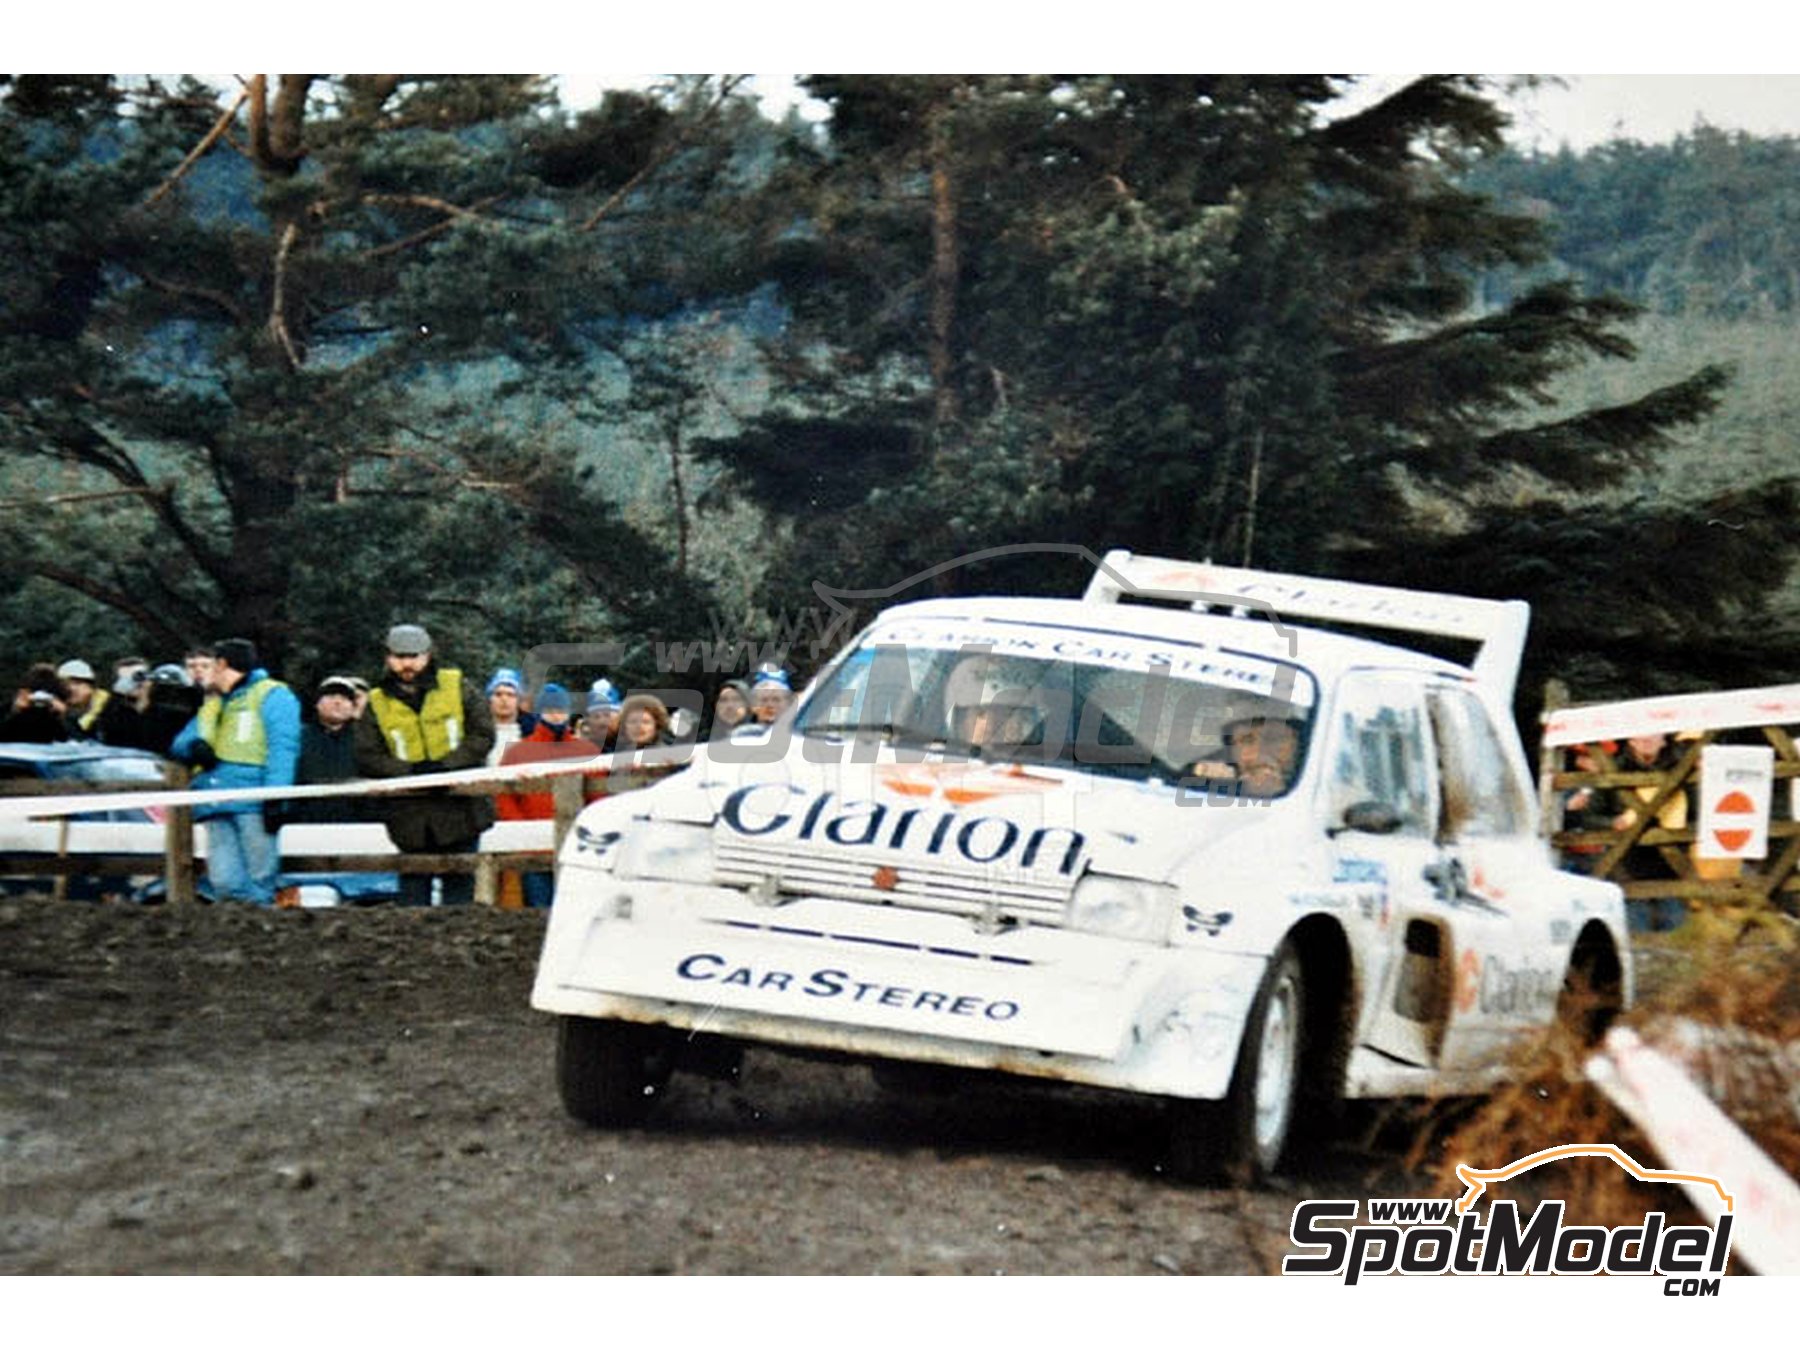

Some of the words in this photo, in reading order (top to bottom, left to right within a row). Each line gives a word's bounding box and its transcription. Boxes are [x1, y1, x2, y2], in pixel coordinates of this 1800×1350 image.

[722, 782, 1085, 875] Clarion
[677, 953, 794, 991] CAR
[803, 970, 1020, 1021] STEREO
